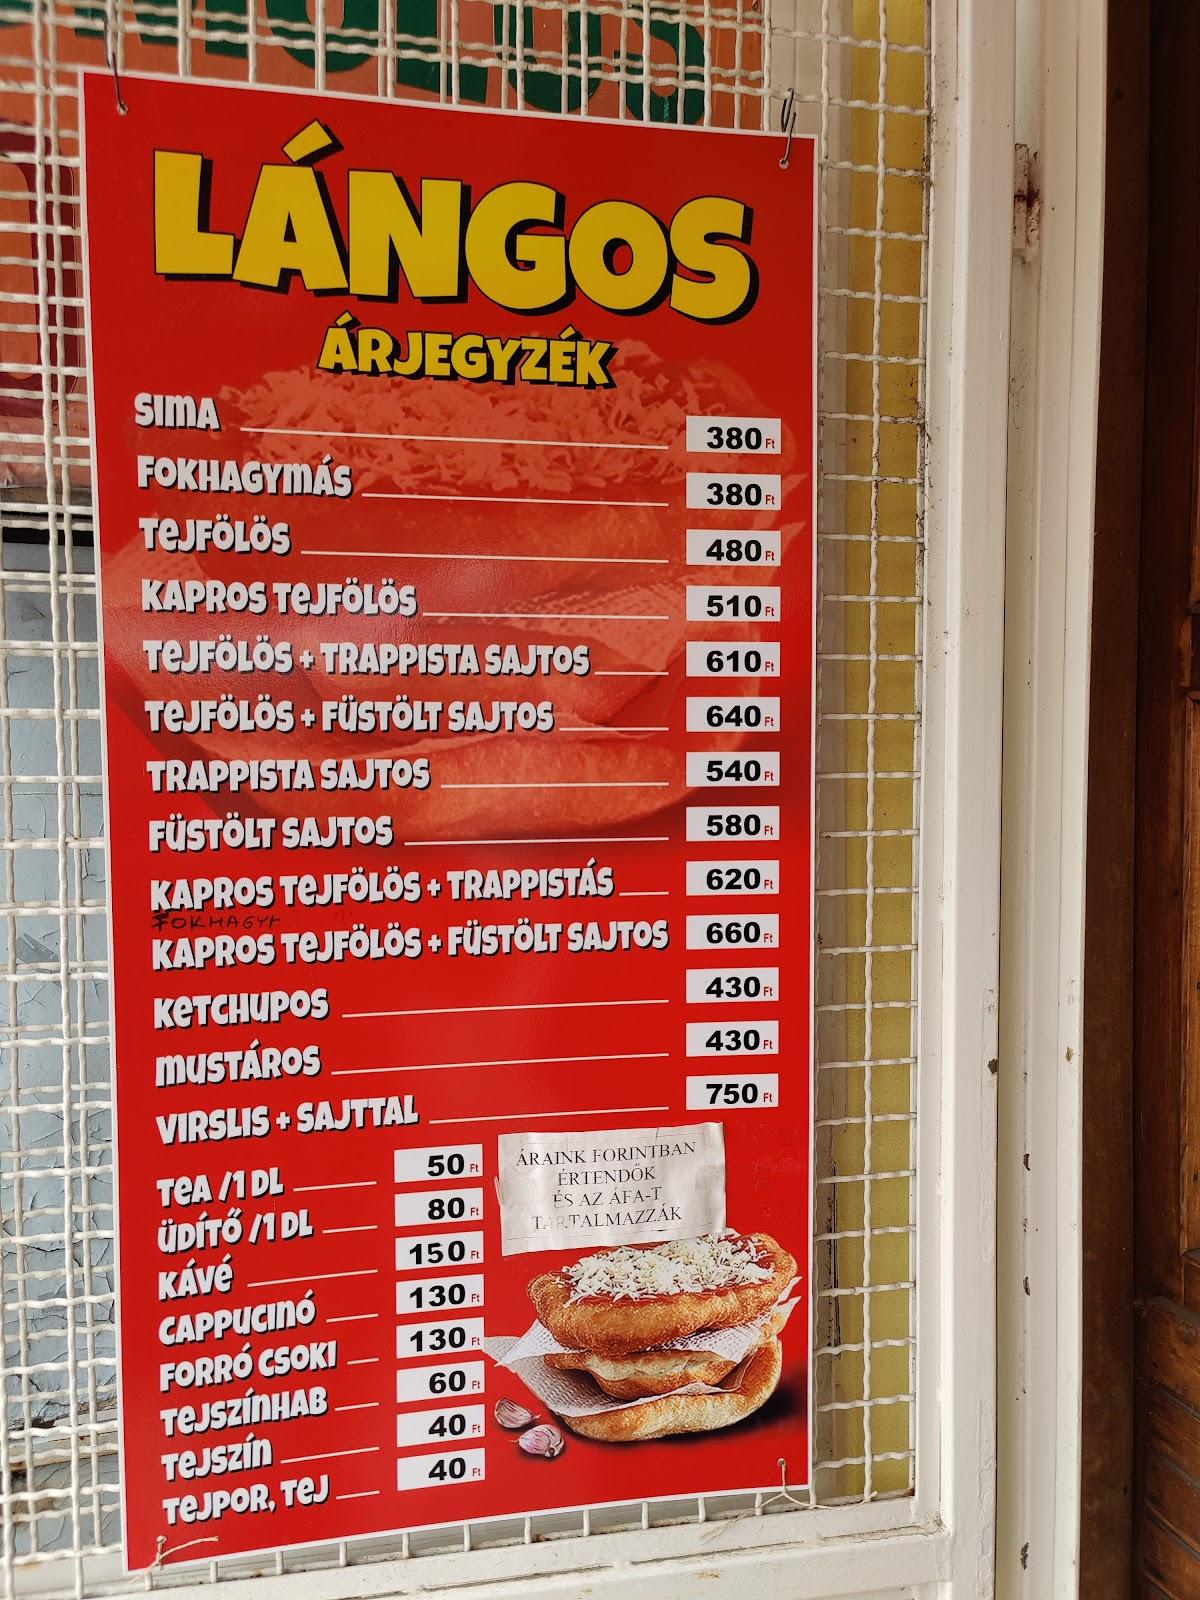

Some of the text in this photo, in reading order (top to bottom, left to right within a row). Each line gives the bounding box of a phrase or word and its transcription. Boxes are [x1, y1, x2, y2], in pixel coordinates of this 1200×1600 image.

[154, 120, 757, 324] LÁNGOS
[318, 311, 618, 387] ÁRJEGYZÉK
[707, 427, 762, 449] 380
[764, 438, 775, 449] Ft
[707, 483, 762, 506] 380
[764, 494, 775, 505] Ft
[707, 539, 762, 561] 480
[764, 550, 775, 561] Ft
[141, 579, 268, 614] KAPROS
[707, 595, 762, 617] 510
[764, 606, 775, 617] Ft
[299, 650, 315, 670] +
[320, 642, 481, 676] TRAPPISTA
[484, 644, 591, 677] SAJTOS
[707, 651, 762, 672] 610
[764, 661, 775, 672] Ft
[301, 709, 316, 728] +
[447, 701, 555, 734] SAJTOS
[707, 706, 761, 727] 640
[764, 716, 775, 727] Ft
[147, 758, 775, 793] TRAPPISTA SAJTOS 540 Ft
[282, 815, 394, 849] SAJTOS
[707, 815, 761, 836] 580
[764, 826, 775, 836] Ft
[151, 876, 275, 912] KAPROS
[427, 879, 441, 898] +
[447, 857, 615, 901] TRAPPISTÁS
[707, 869, 761, 890] 620
[764, 880, 775, 890] Ft
[152, 934, 276, 971] KAPROS
[428, 935, 442, 953] +
[567, 920, 669, 953] SAJTOS
[707, 922, 761, 943] 660
[764, 933, 775, 943] Ft
[706, 977, 760, 998] 430
[764, 986, 775, 997] Ft
[706, 1030, 760, 1051] 430
[764, 1040, 775, 1050] Ft
[156, 1084, 775, 1146] VIRSLIS + SAJTTAL 750 Ft
[516, 1142, 697, 1167] ÁRAINK FORINTBAN
[251, 1167, 284, 1198] DL
[428, 1153, 465, 1176] 50
[470, 1163, 480, 1173] Ft
[557, 1163, 656, 1187] ÉRTENDŐK
[553, 1186, 663, 1208] ÉS AZ ÁFA-T
[281, 1209, 314, 1240] DL
[428, 1197, 465, 1220] 80
[470, 1206, 480, 1216] Ft
[532, 1204, 683, 1230] TARTALMAZZÁK
[409, 1240, 466, 1265] 150
[471, 1250, 480, 1260] Ft
[410, 1283, 466, 1308] 130
[471, 1293, 480, 1303] Ft
[159, 1326, 481, 1393] FORRÓ CSOKI 130 Ft
[429, 1370, 466, 1394] 60
[471, 1379, 481, 1390] Ft
[428, 1413, 466, 1437] 40
[472, 1423, 481, 1433] Ft
[428, 1457, 466, 1481] 40
[472, 1467, 481, 1477] Ft
